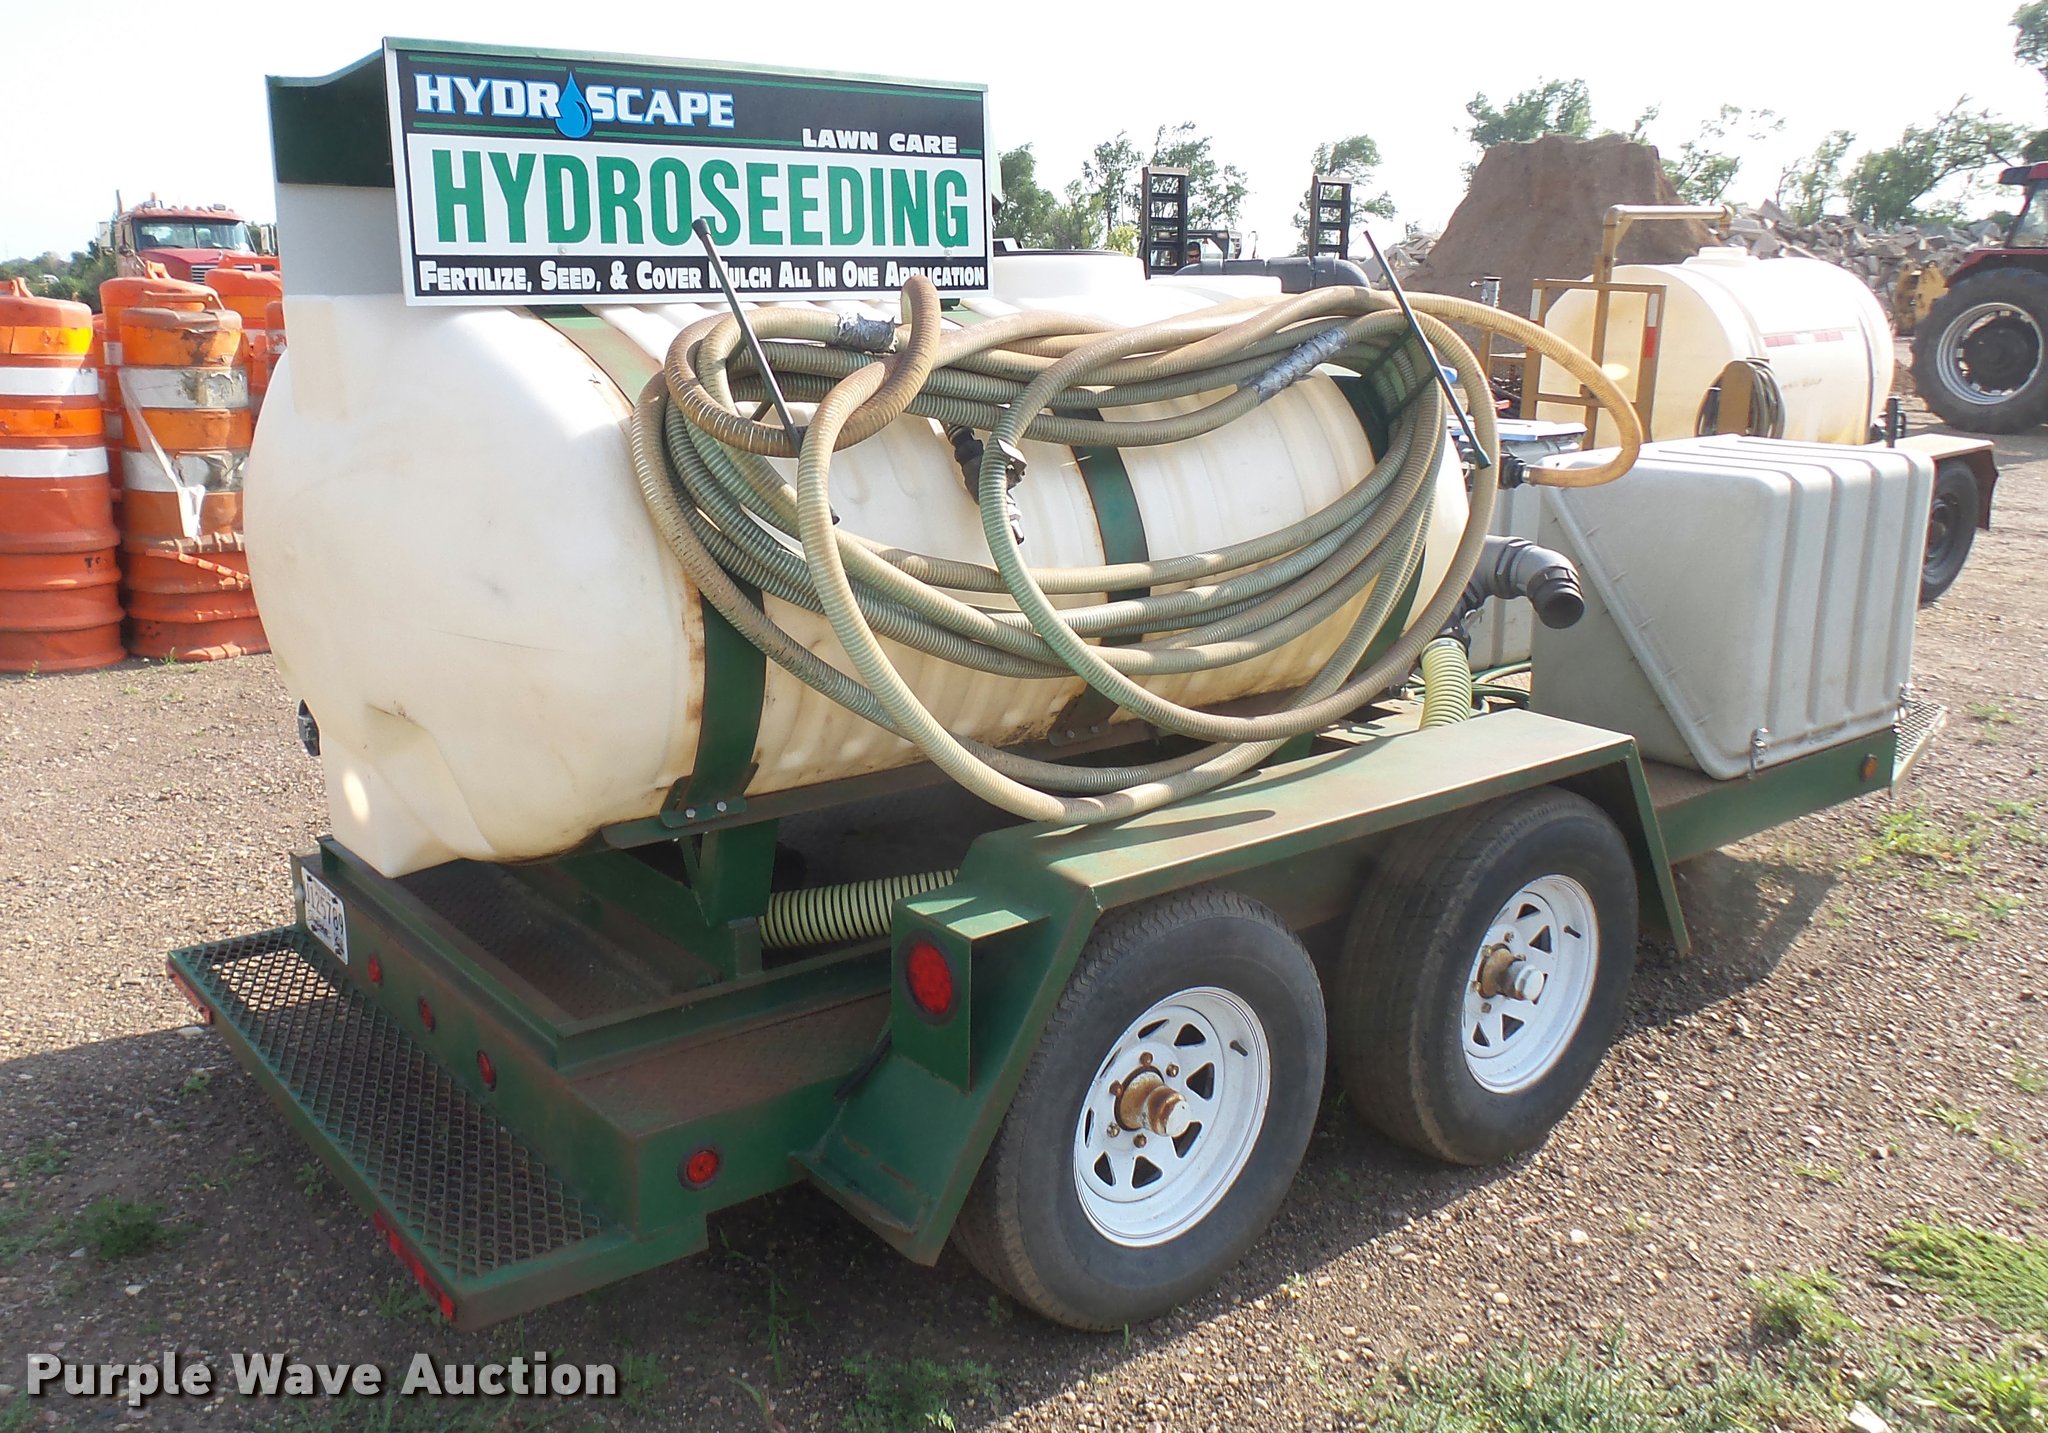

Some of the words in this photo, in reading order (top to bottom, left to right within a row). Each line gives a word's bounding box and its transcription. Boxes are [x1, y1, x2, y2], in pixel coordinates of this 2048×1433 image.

[802, 128, 878, 151] LAWN
[889, 132, 957, 155] CARE
[432, 149, 969, 248] HYDROSEEDING
[419, 260, 532, 293] FERTILIZE,
[540, 260, 601, 293] SEED,
[610, 260, 629, 290] &
[636, 261, 702, 290] COVER
[778, 260, 812, 289] ALL
[817, 260, 837, 288] IN
[842, 260, 879, 288] ONE
